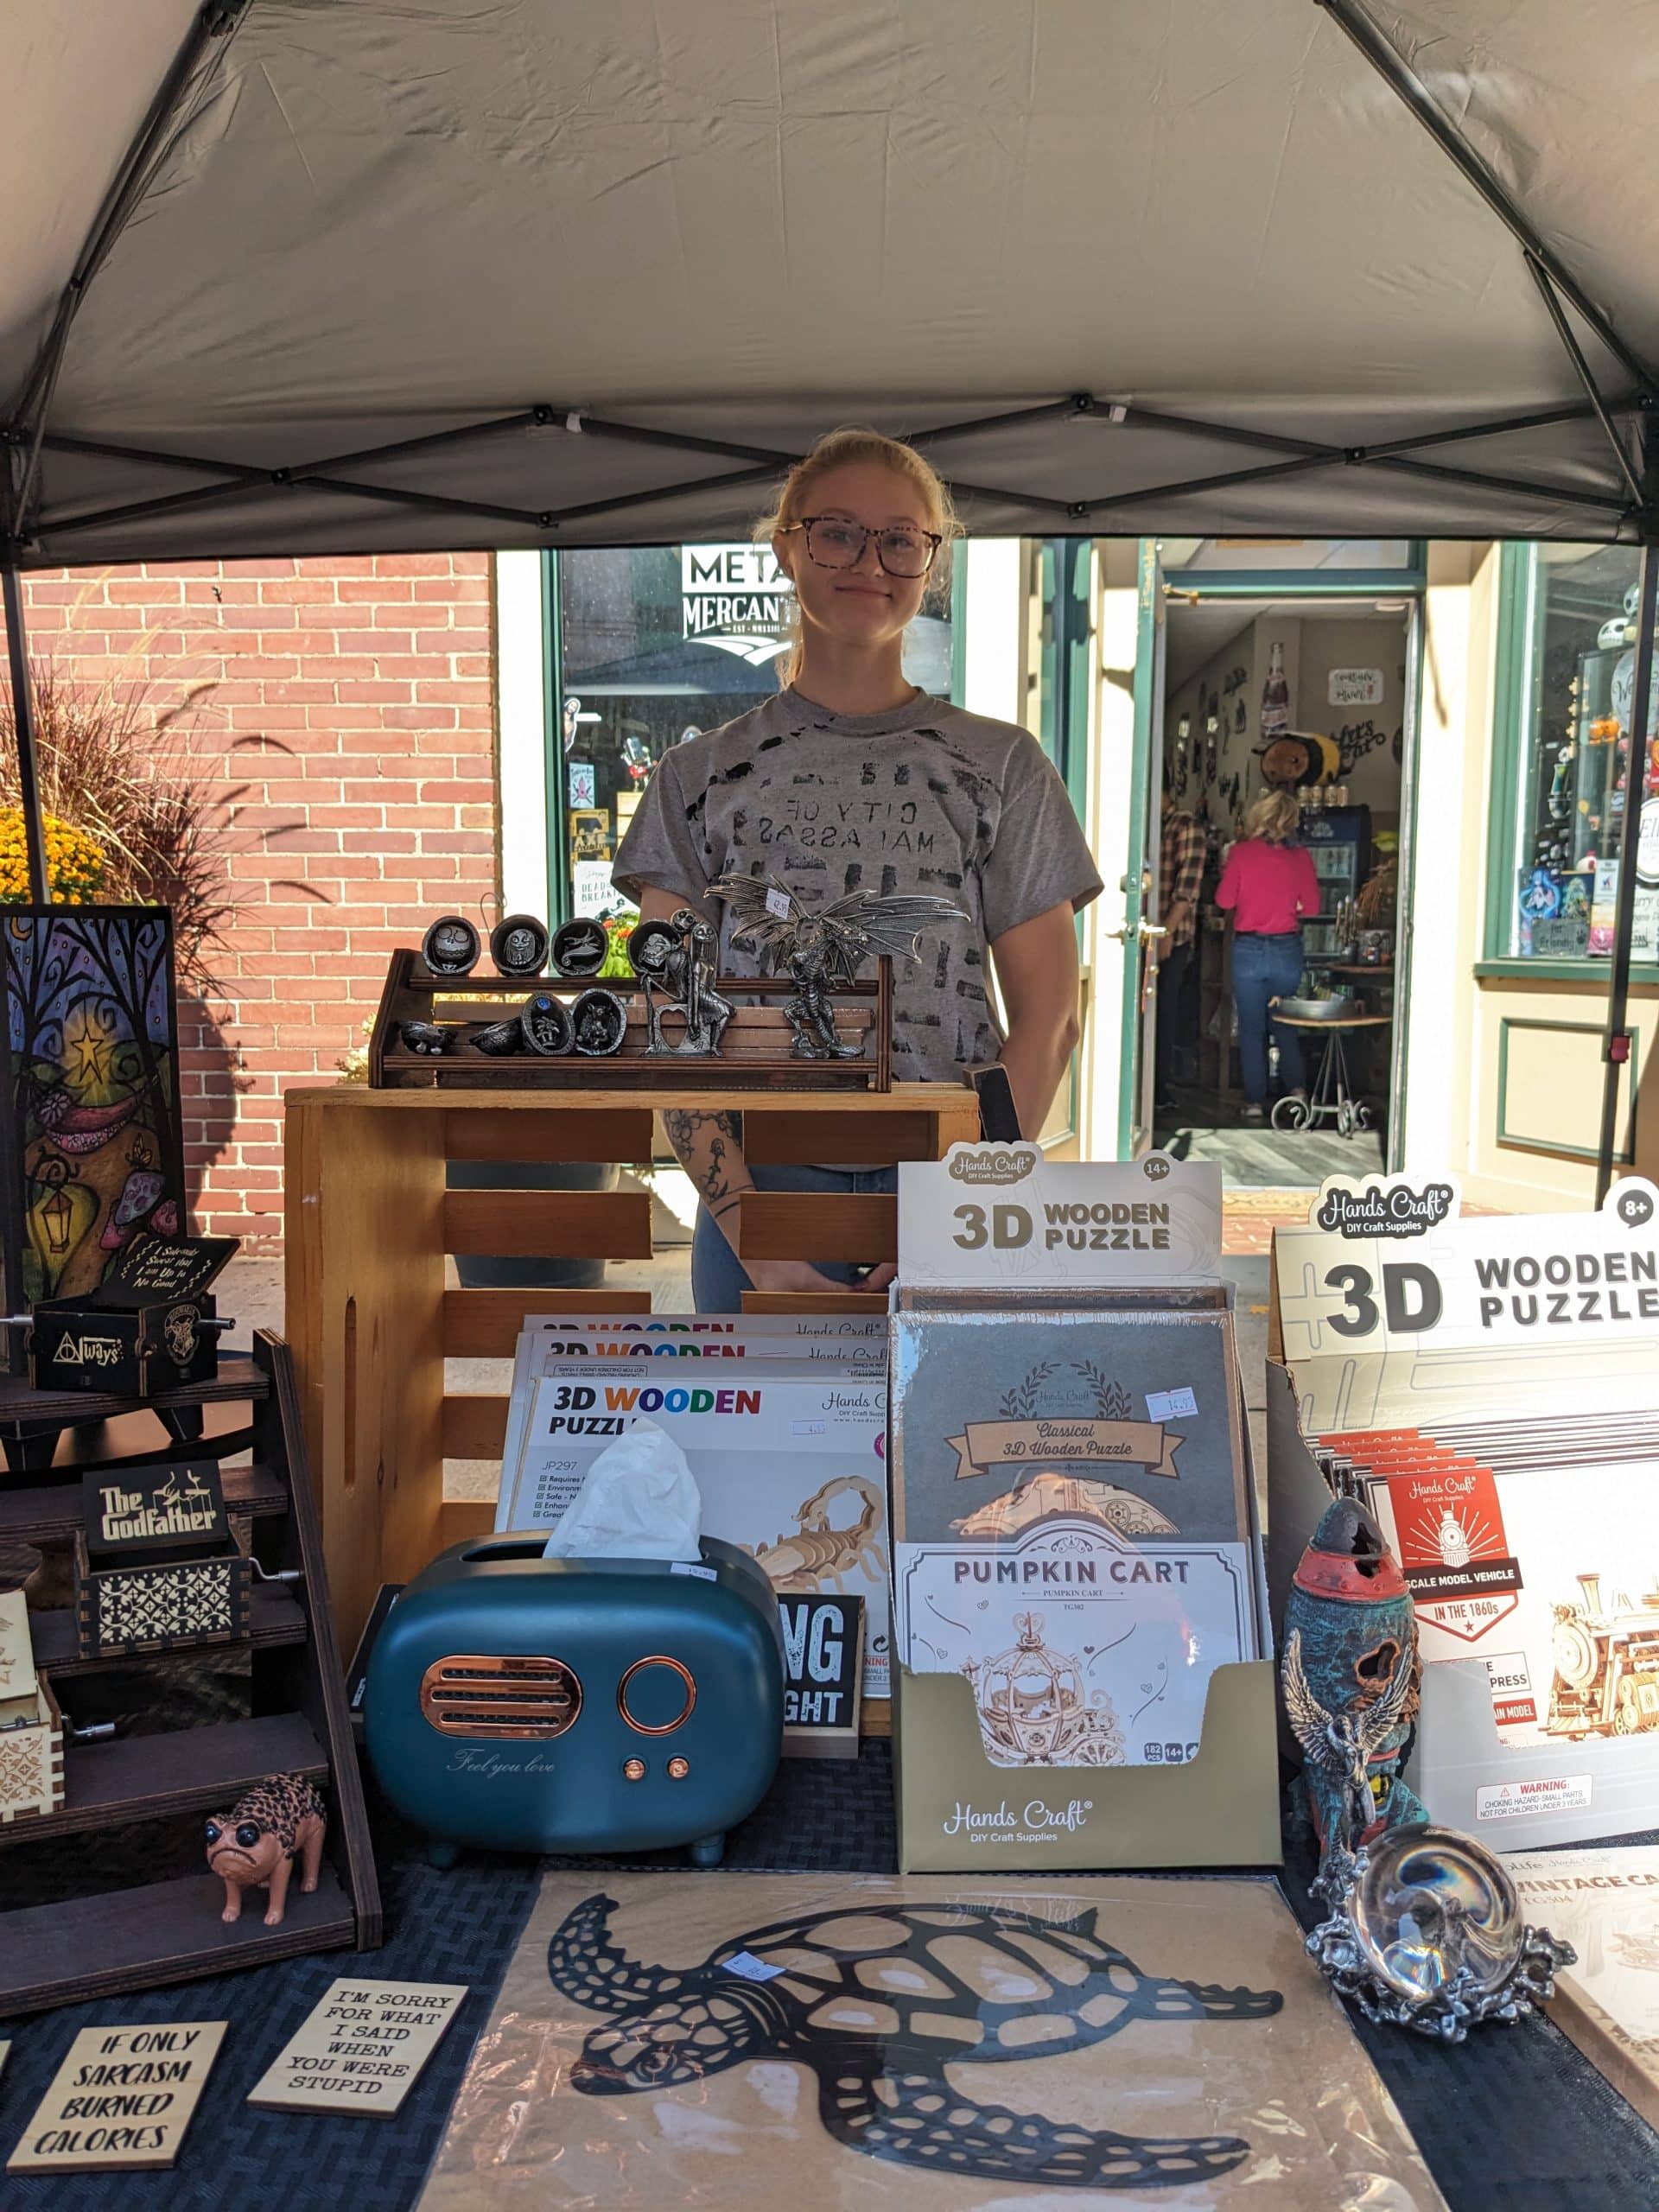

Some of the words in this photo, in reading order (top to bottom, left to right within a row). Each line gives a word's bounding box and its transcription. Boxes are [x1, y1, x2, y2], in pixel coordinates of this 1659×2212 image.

[955, 1156, 992, 1174] Hands
[1147, 1163, 1170, 1175] 14+
[1323, 1192, 1385, 1225] Hands
[1624, 1200, 1648, 1216] 8+
[952, 1204, 1033, 1250] 3D
[1044, 1203, 1171, 1225] WOODEN
[1346, 1223, 1362, 1233] DIY
[1363, 1222, 1384, 1232] Craft
[1385, 1220, 1422, 1233] Supplies
[1045, 1228, 1171, 1250] PUZZLE
[1324, 1262, 1444, 1338] 3D
[1474, 1250, 1659, 1289] WOODEN
[1479, 1287, 1659, 1328] PUZZLE
[554, 1386, 596, 1411] 3D
[604, 1387, 762, 1414] WOODEN
[822, 1391, 870, 1410] Hands
[549, 1416, 633, 1436] PUZZL
[1036, 1422, 1095, 1438] Classical
[1002, 1440, 1027, 1456] 3D
[1029, 1440, 1084, 1456] Wooden
[1085, 1440, 1133, 1456] Puzzle
[542, 1461, 578, 1471] JP297
[549, 1475, 581, 1484] Requires
[99, 1485, 143, 1512] The
[1409, 1480, 1443, 1499] Hands
[101, 1503, 217, 1541] Godfather
[954, 1560, 1096, 1585] PUMPKIN
[1109, 1560, 1190, 1585] CART
[1440, 1573, 1472, 1586] MODEL
[1474, 1568, 1515, 1583] VEHICLE
[1043, 1589, 1080, 1598] PUMPKIN
[1081, 1589, 1103, 1598] CART
[1434, 1607, 1446, 1621] IN
[1449, 1605, 1466, 1619] THE
[1471, 1602, 1499, 1617] 1860s
[1507, 1704, 1535, 1719] MODEL
[1144, 1745, 1161, 1754] 182
[1166, 1747, 1182, 1758] 14+
[524, 1758, 556, 1773] love
[944, 1800, 1018, 1834] Hands
[970, 1834, 988, 1843] DIY
[990, 1833, 1014, 1842] Craft
[1016, 1832, 1058, 1843] Supplies
[333, 1991, 369, 2005] I'M
[375, 1993, 454, 2009] SORRY
[325, 2007, 372, 2021] FOR
[378, 2010, 442, 2025] WHAT
[330, 2024, 344, 2037] I
[351, 2024, 410, 2040] SAID
[99, 2034, 131, 2055] IF
[130, 2030, 201, 2053] ONLY
[328, 2041, 394, 2057] WHEN
[73, 2060, 192, 2088] SARCASM
[286, 2056, 336, 2072] YOU
[343, 2060, 410, 2078] WERE
[288, 2075, 383, 2095] STUPID
[60, 2093, 175, 2120] BURNED
[34, 2125, 168, 2156] CALORIES
